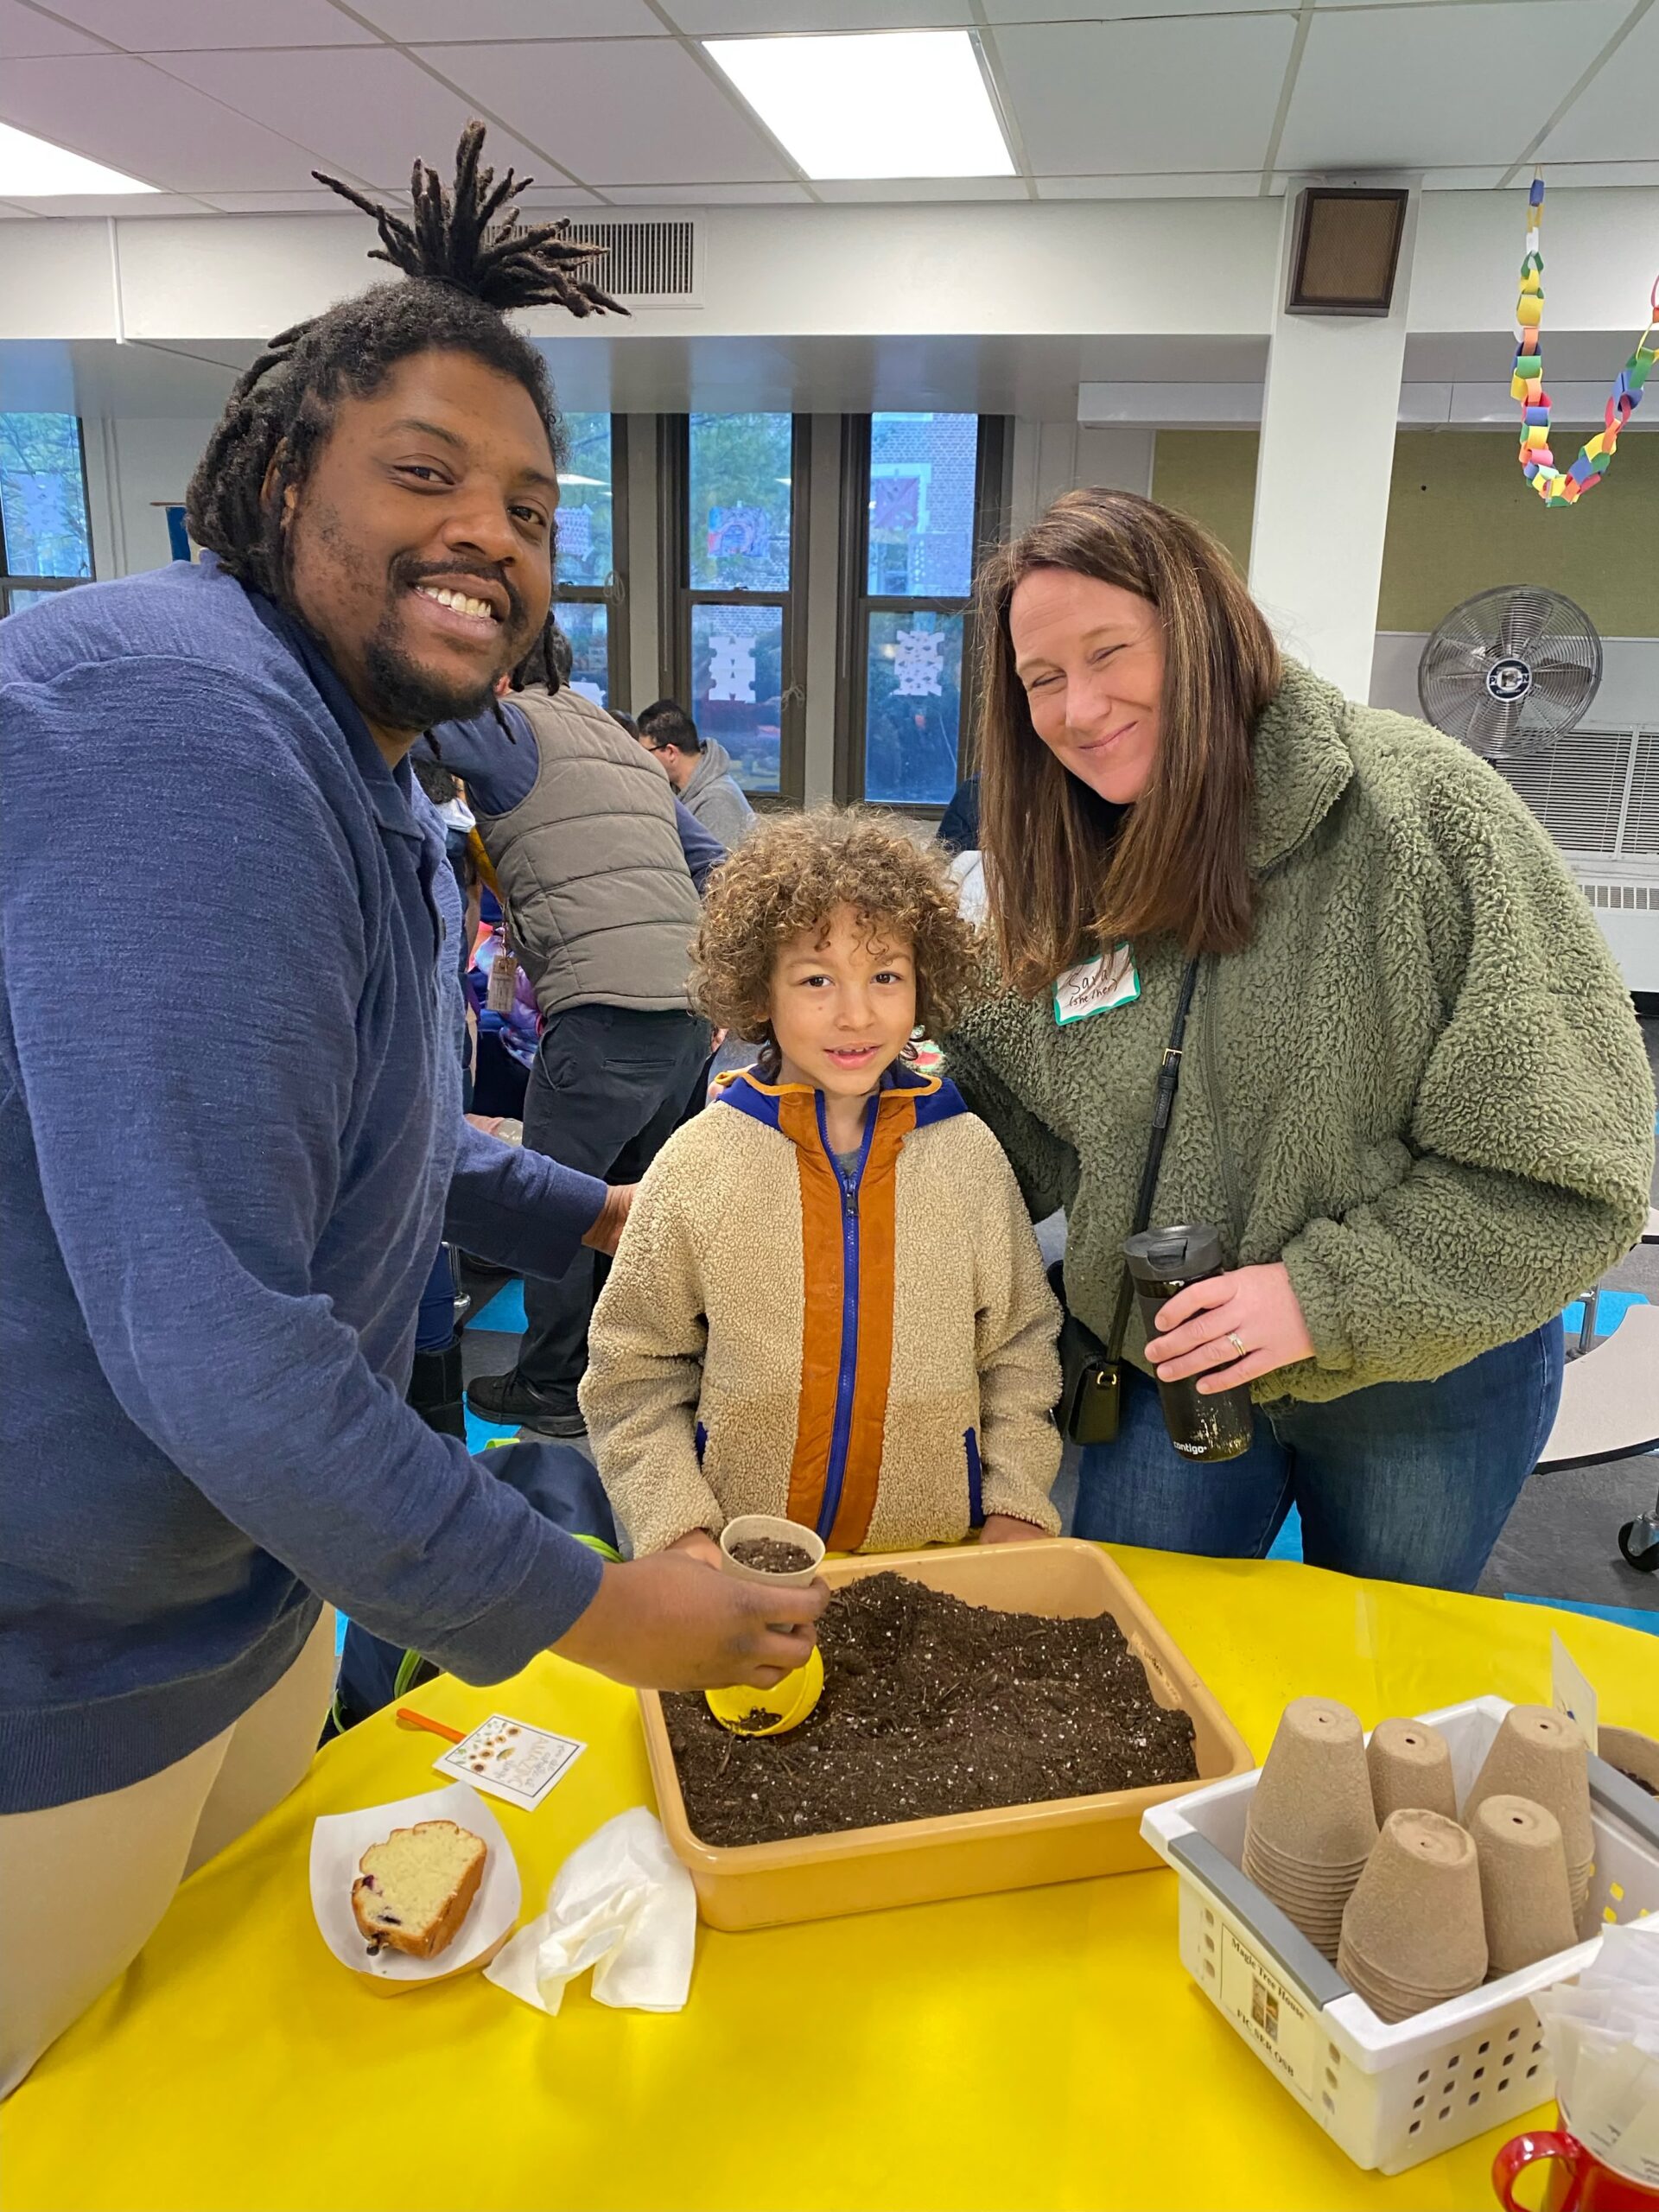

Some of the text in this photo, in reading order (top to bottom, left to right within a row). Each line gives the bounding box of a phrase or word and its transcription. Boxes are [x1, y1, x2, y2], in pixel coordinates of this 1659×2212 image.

[1068, 969, 1109, 995] Sara
[1173, 1440, 1205, 1455] contigo
[1231, 1937, 1305, 2020] Magic Tree House
[1236, 2009, 1254, 2029] FIC
[1254, 2030, 1273, 2054] SER
